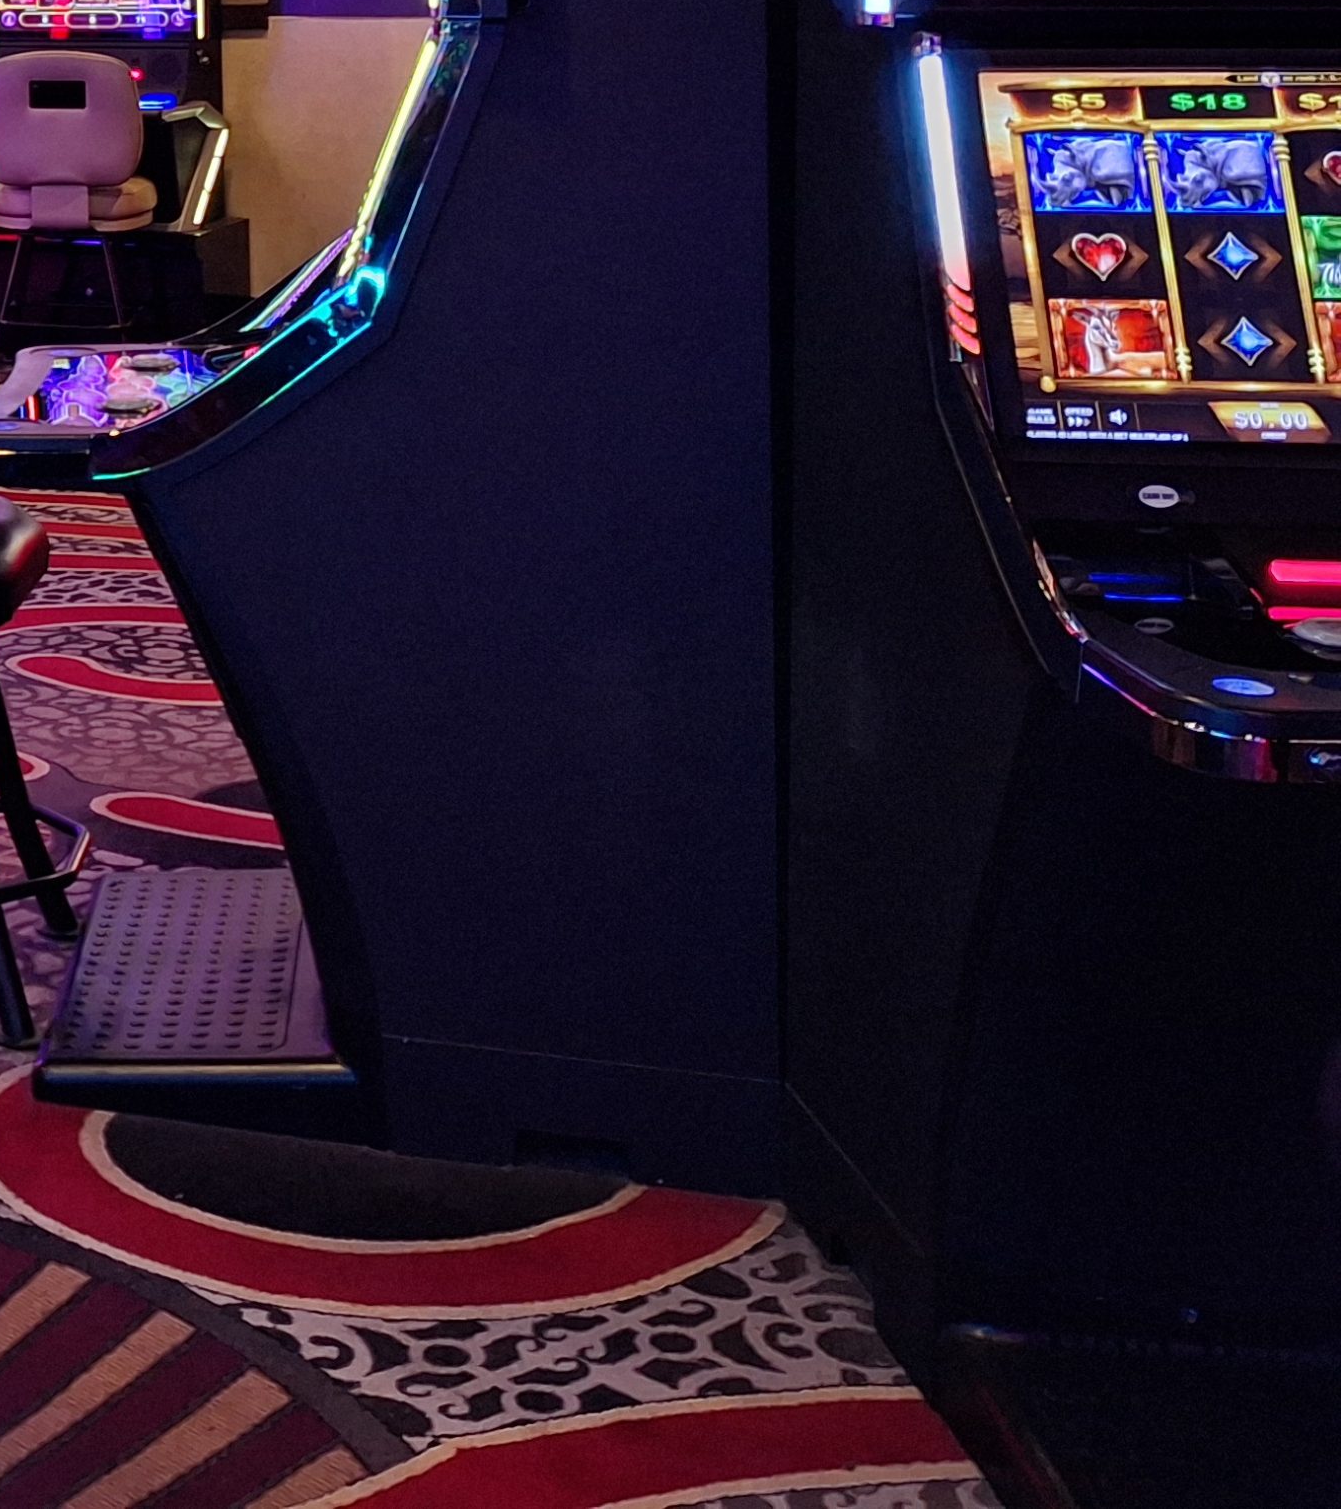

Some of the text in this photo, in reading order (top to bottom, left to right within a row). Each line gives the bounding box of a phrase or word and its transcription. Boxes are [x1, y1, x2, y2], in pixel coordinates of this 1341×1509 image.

[1051, 92, 1107, 111] $5
[1170, 92, 1247, 112] $18
[1064, 407, 1094, 417] SPEED
